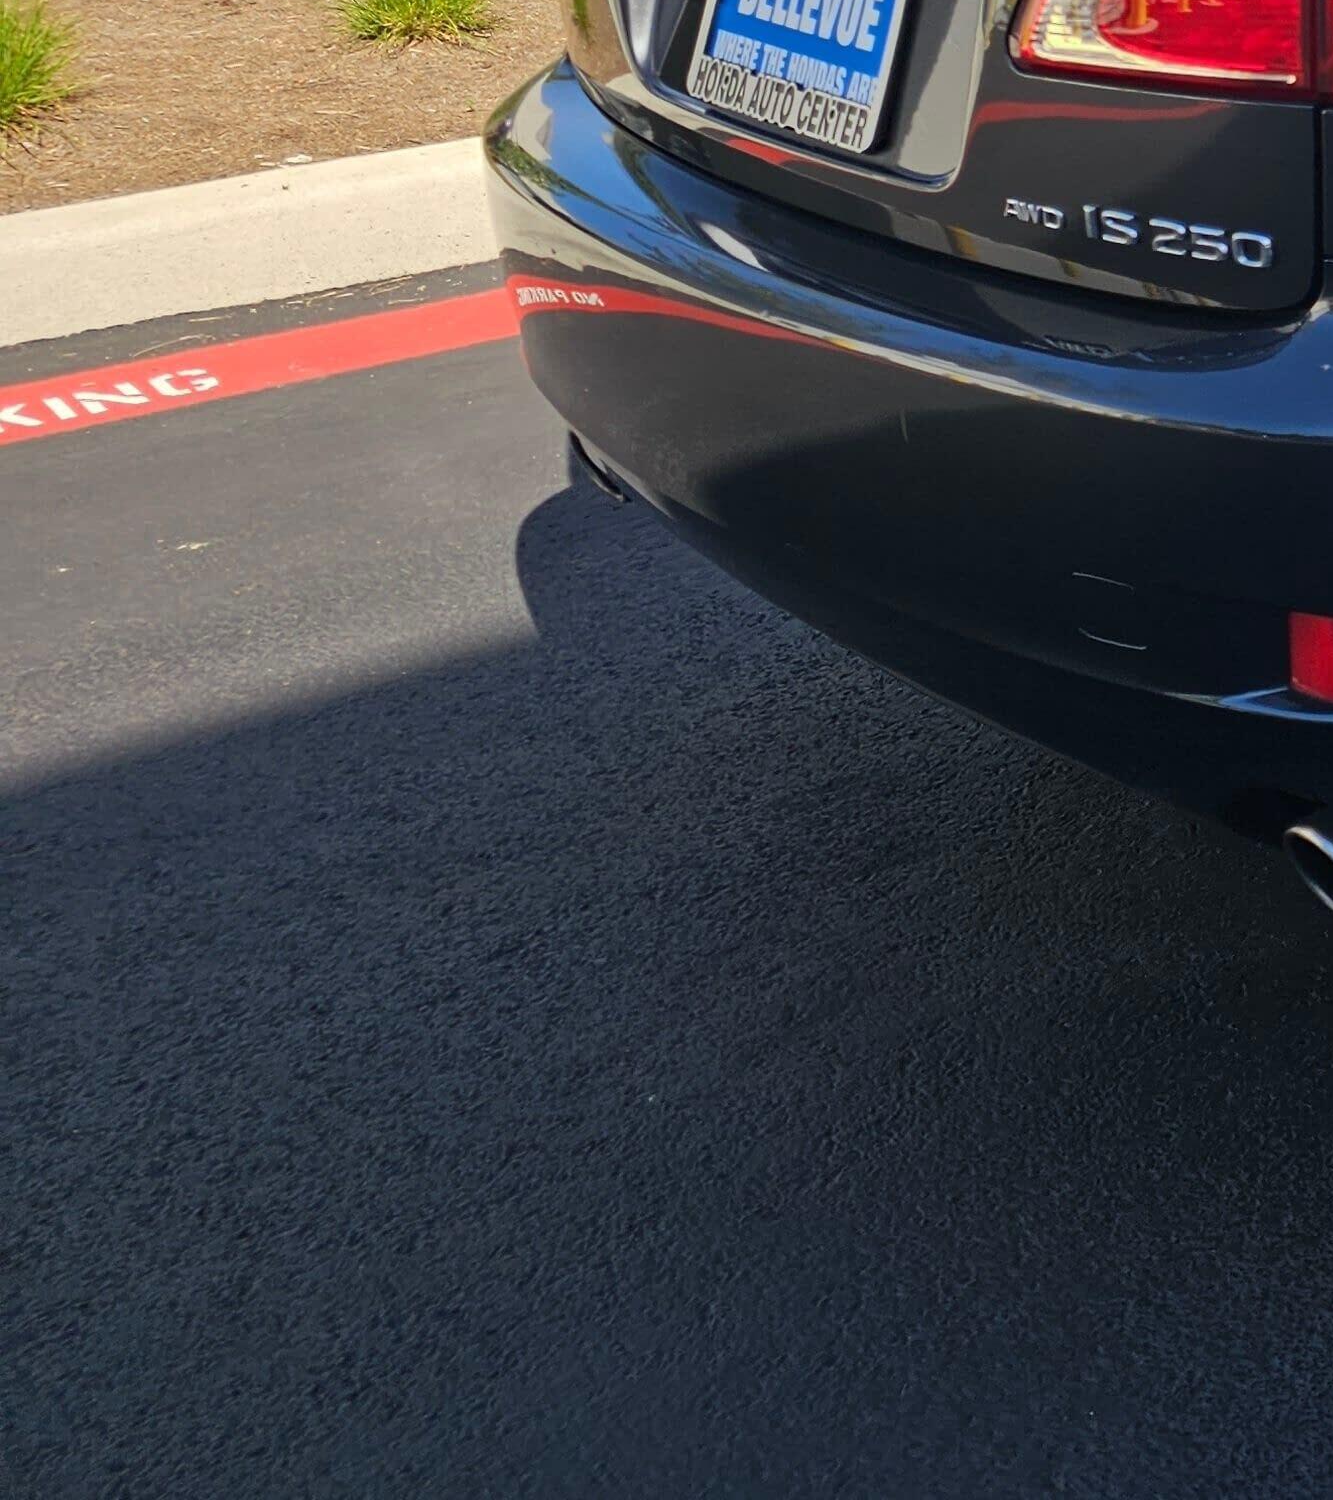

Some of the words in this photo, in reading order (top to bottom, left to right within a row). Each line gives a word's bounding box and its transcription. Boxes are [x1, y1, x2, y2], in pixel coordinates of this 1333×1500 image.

[712, 29, 762, 71] WHERE
[761, 43, 788, 78] THE
[786, 52, 848, 98] HONDAS
[692, 57, 751, 111] HONDA
[749, 76, 797, 123] AUTO
[796, 90, 870, 150] CENTER
[1003, 198, 1065, 231] AWD
[1082, 203, 1139, 246] IS
[1149, 218, 1273, 268] 250
